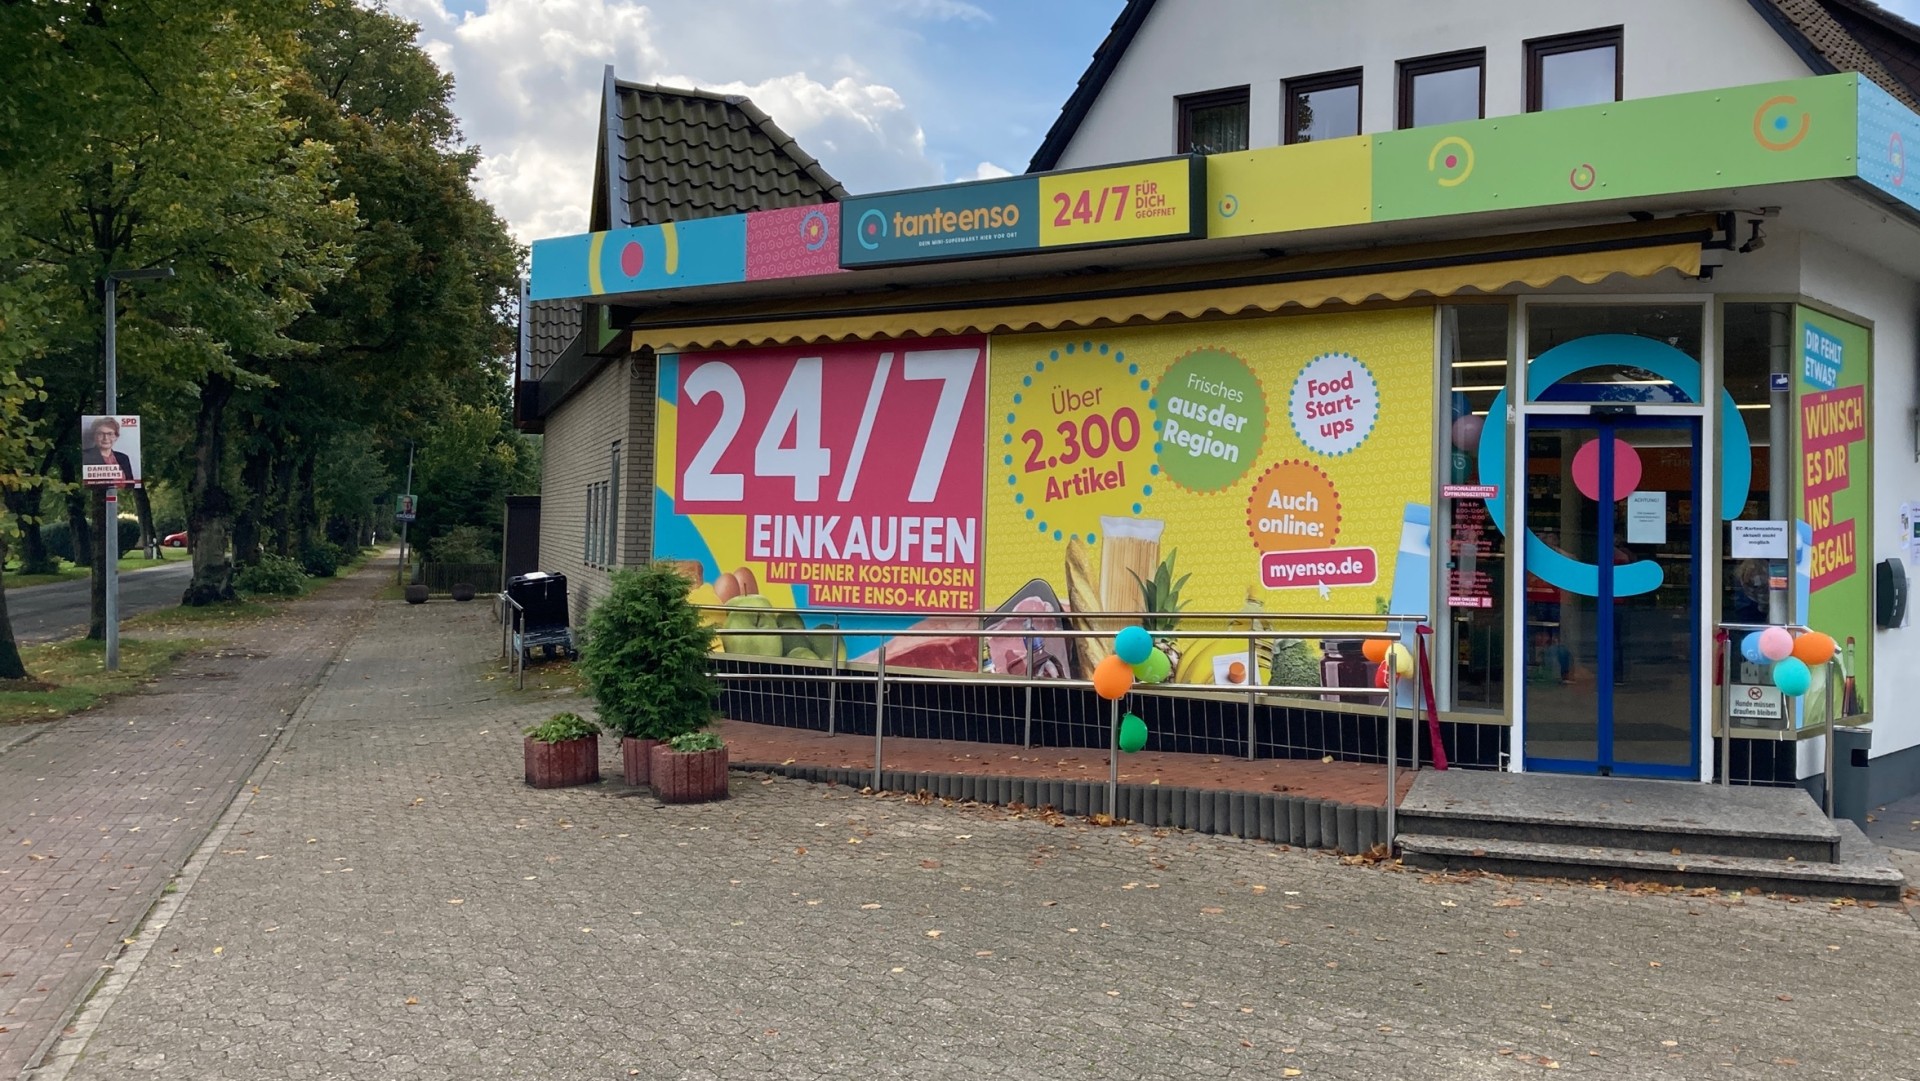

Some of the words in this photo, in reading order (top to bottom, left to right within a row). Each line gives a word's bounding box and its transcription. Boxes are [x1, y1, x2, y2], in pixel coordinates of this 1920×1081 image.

[1135, 180, 1158, 196] FÜR
[1135, 194, 1166, 209] DICH
[893, 204, 1020, 238] tanteenso
[1053, 185, 1131, 227] 24/7
[1135, 207, 1177, 219] GEÖFFNET
[980, 233, 992, 241] HIER
[994, 232, 1005, 240] VOR
[1006, 231, 1018, 239] ORT
[1805, 329, 1820, 354] DIR
[1820, 336, 1843, 365] FEHLT
[1307, 370, 1354, 398] Food
[1805, 355, 1837, 388] ETWAS?
[1051, 385, 1103, 415] Über
[1186, 372, 1244, 403] Frisches
[1305, 394, 1361, 420] Start-
[1804, 393, 1863, 440] WÜNSCH
[682, 347, 981, 502] 24/7
[1020, 406, 1141, 474] 2.300
[1320, 418, 1355, 440] ups
[1163, 418, 1240, 464] Region
[1806, 450, 1822, 487] ES
[1824, 444, 1847, 482] DIR
[1045, 460, 1126, 503] Artikel
[1267, 489, 1319, 512] Auch
[1808, 494, 1831, 532] INS
[752, 514, 976, 564] EINKAUFEN
[1258, 514, 1325, 538] online:
[1270, 556, 1364, 582] myenso.de
[1810, 531, 1854, 580] REGAL!
[770, 562, 798, 580] MIT
[801, 563, 855, 582] DEINER
[859, 566, 975, 588] KOSTENLOSEN
[813, 584, 862, 605] TANTE
[865, 587, 974, 610] ENSO-KARTE!
